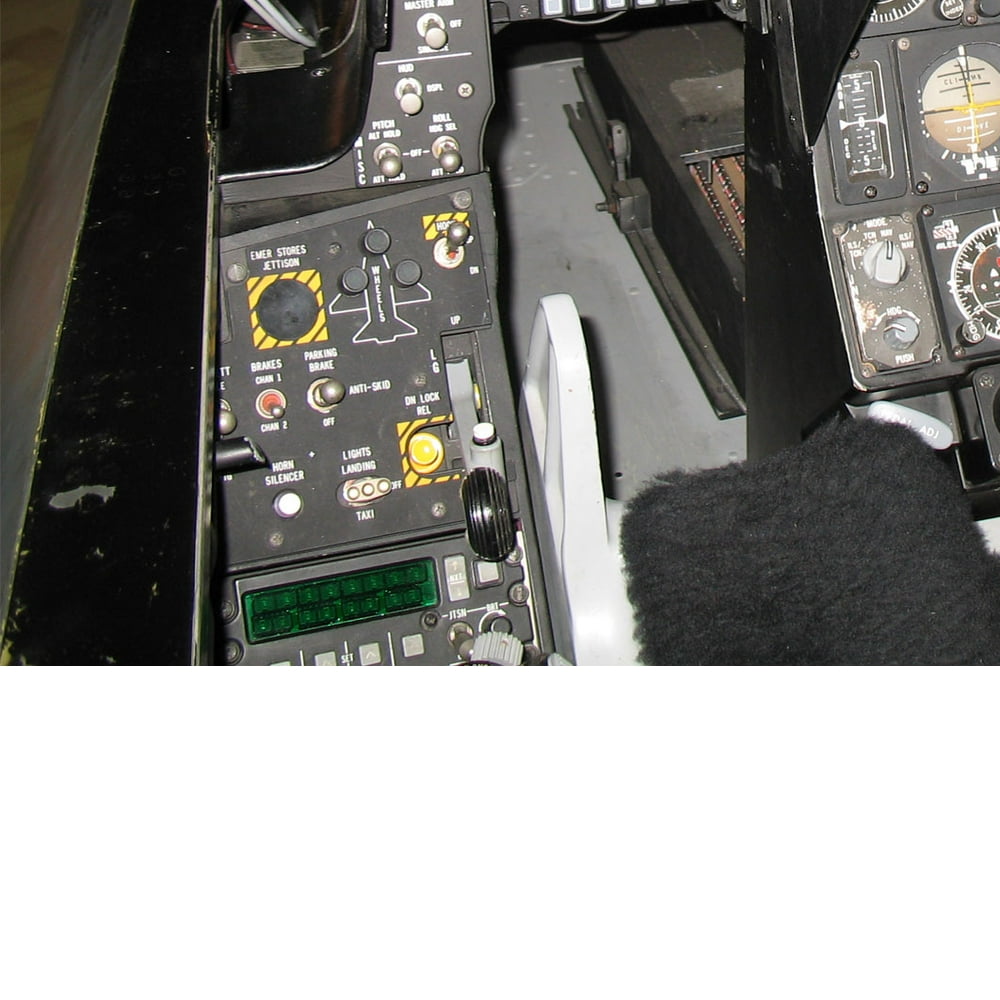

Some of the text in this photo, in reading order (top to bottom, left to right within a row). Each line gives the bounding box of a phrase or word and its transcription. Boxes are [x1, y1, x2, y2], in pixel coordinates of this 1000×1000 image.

[404, 0, 435, 11] MASTER
[450, 19, 463, 28] OFF
[398, 63, 415, 73] HUD
[854, 79, 861, 90] 5
[432, 113, 452, 123] ROLL
[372, 120, 395, 130] PITCH
[444, 123, 458, 131] SEL
[368, 130, 401, 140] ALT HOLD
[409, 148, 422, 157] OFF
[863, 154, 870, 166] 5
[250, 244, 307, 261] EMER STORES
[262, 257, 300, 269] JETTISON
[371, 265, 386, 323] WHEELS
[886, 306, 904, 317] HDG
[450, 315, 461, 325] UP
[304, 347, 338, 361] PARKING
[895, 353, 915, 365] PUSH
[250, 359, 283, 373] BRAKES
[308, 360, 335, 373] BRAKE
[255, 373, 282, 385] CHAN 1
[349, 380, 391, 396] ANTI-SKID
[405, 391, 440, 407] DN LOCK
[417, 404, 431, 416] REL
[261, 420, 288, 433] CHAN 2
[322, 417, 335, 427] OFF
[919, 424, 940, 439] ADJ
[342, 446, 372, 461] LIGHTS
[272, 459, 295, 473] HORN
[341, 460, 376, 475] LANDING
[265, 470, 305, 486] SILENCER
[356, 509, 375, 521] TAXI
[449, 608, 467, 620] JTSN
[340, 653, 354, 664] SET
